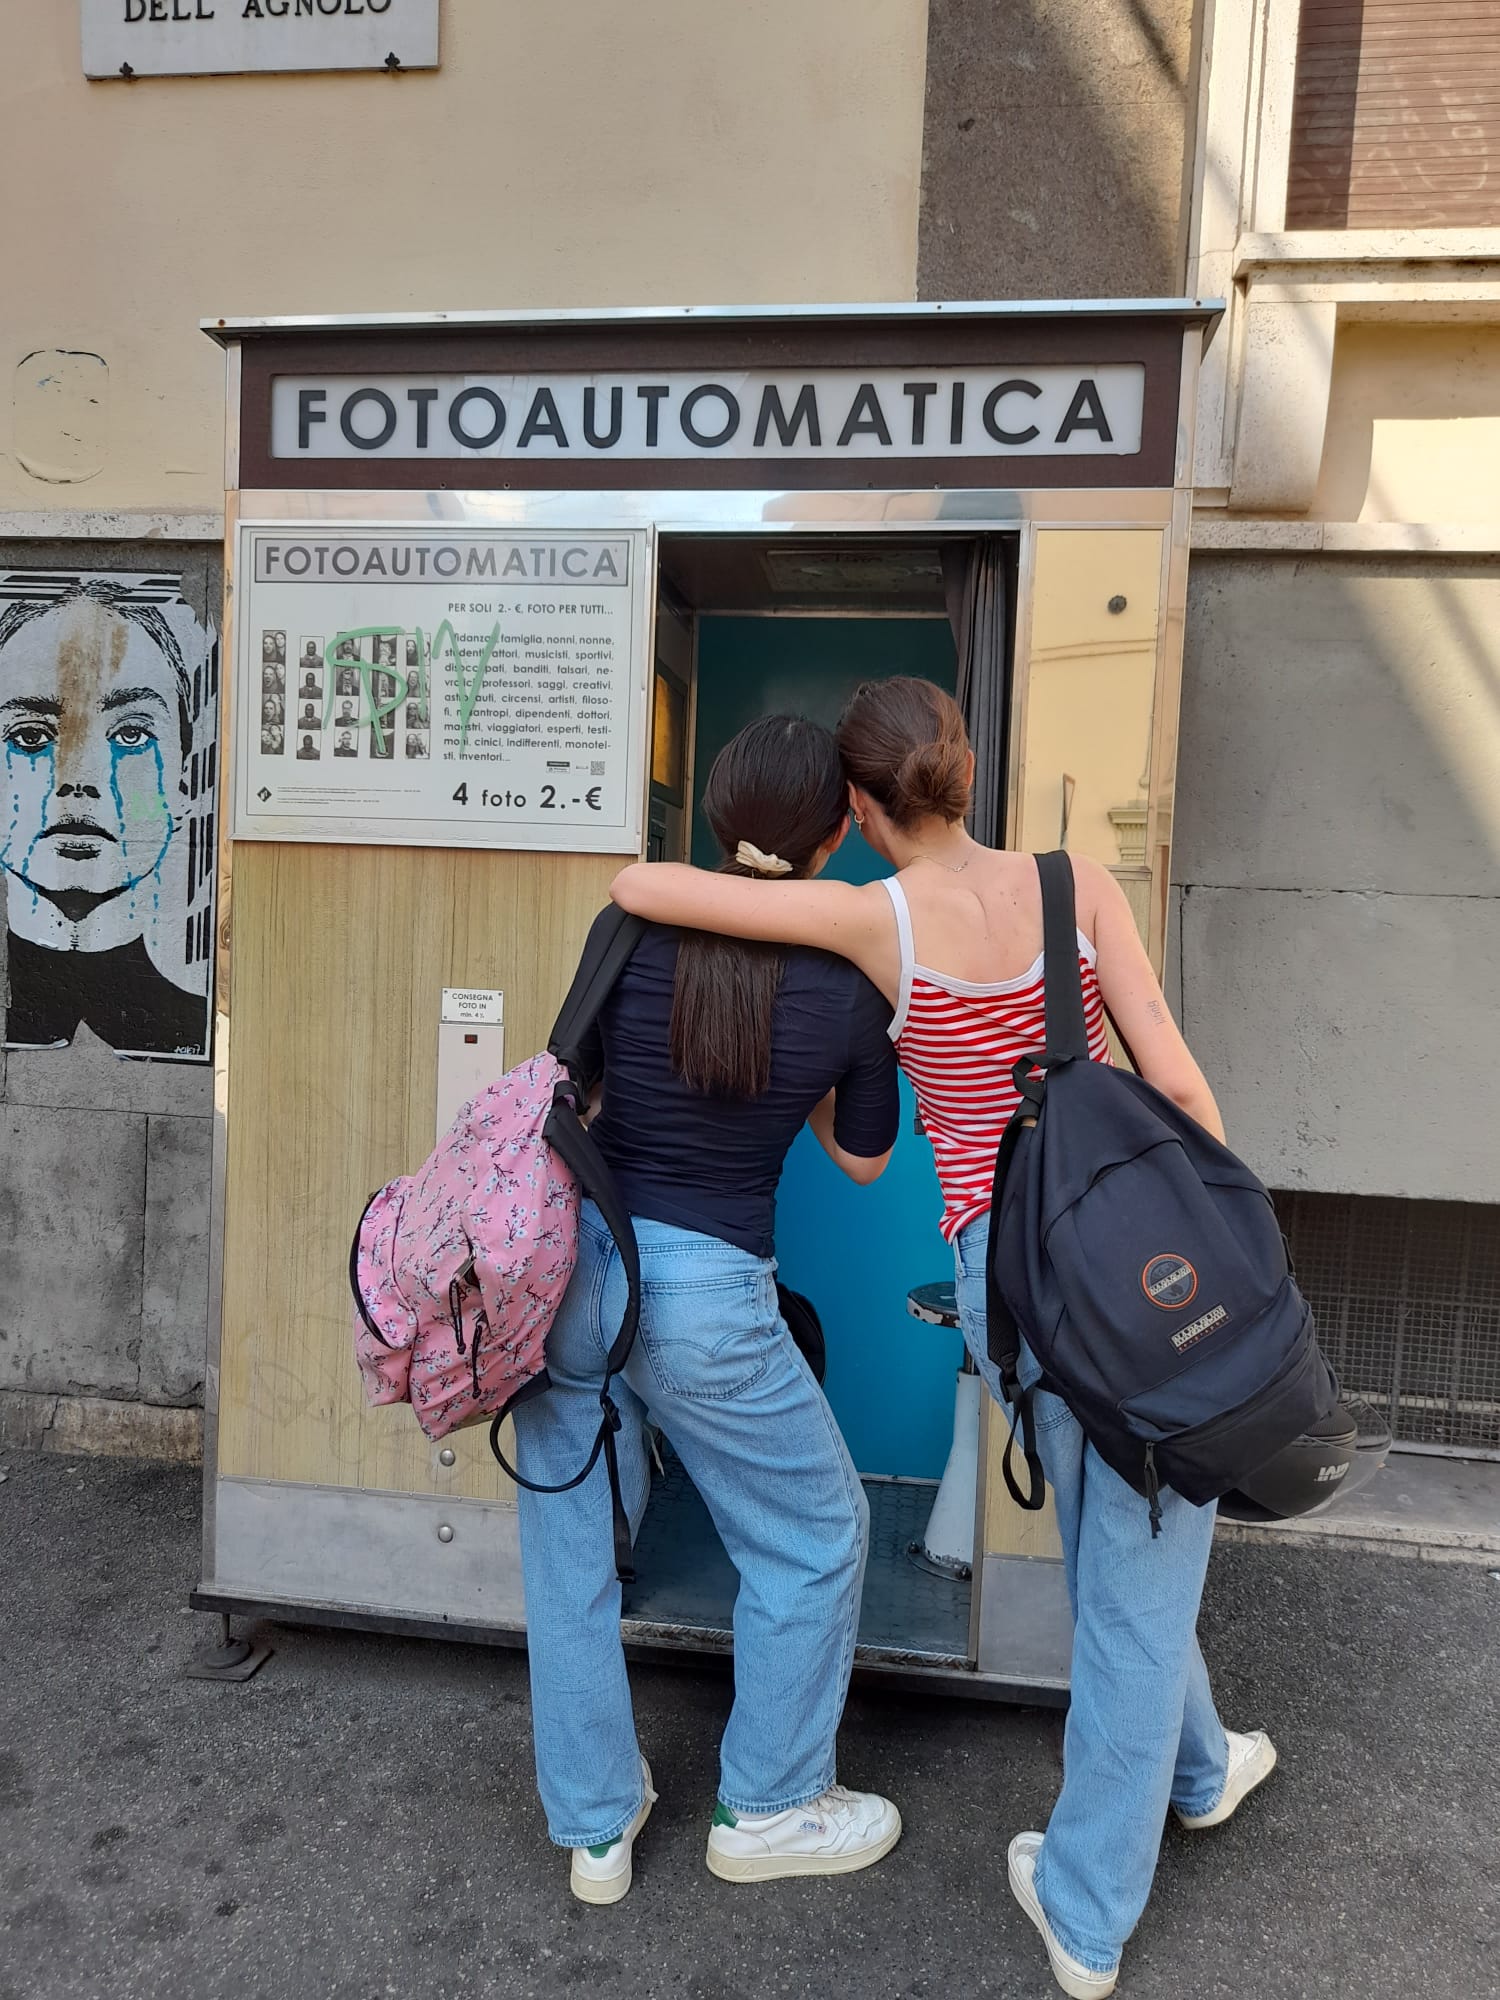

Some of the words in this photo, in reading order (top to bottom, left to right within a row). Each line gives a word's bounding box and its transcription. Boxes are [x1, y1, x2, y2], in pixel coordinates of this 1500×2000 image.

[297, 379, 1113, 449] FOTOAUTOMATICA
[265, 546, 618, 577] FOTOAUTOMATICA
[448, 603, 466, 613] PER
[469, 603, 492, 613] SOLI
[528, 604, 555, 614] FOTO
[559, 604, 577, 614] PER
[580, 604, 613, 615] TUTTI...
[501, 634, 545, 645] famiglia,
[579, 636, 614, 646] nonne,
[596, 667, 613, 675] ne-
[582, 695, 613, 705] filoso-
[576, 710, 613, 720] dottori,
[587, 725, 612, 734] testi-
[452, 782, 468, 805] 4
[482, 789, 526, 807] foto
[452, 993, 493, 1001] CONSEGNA
